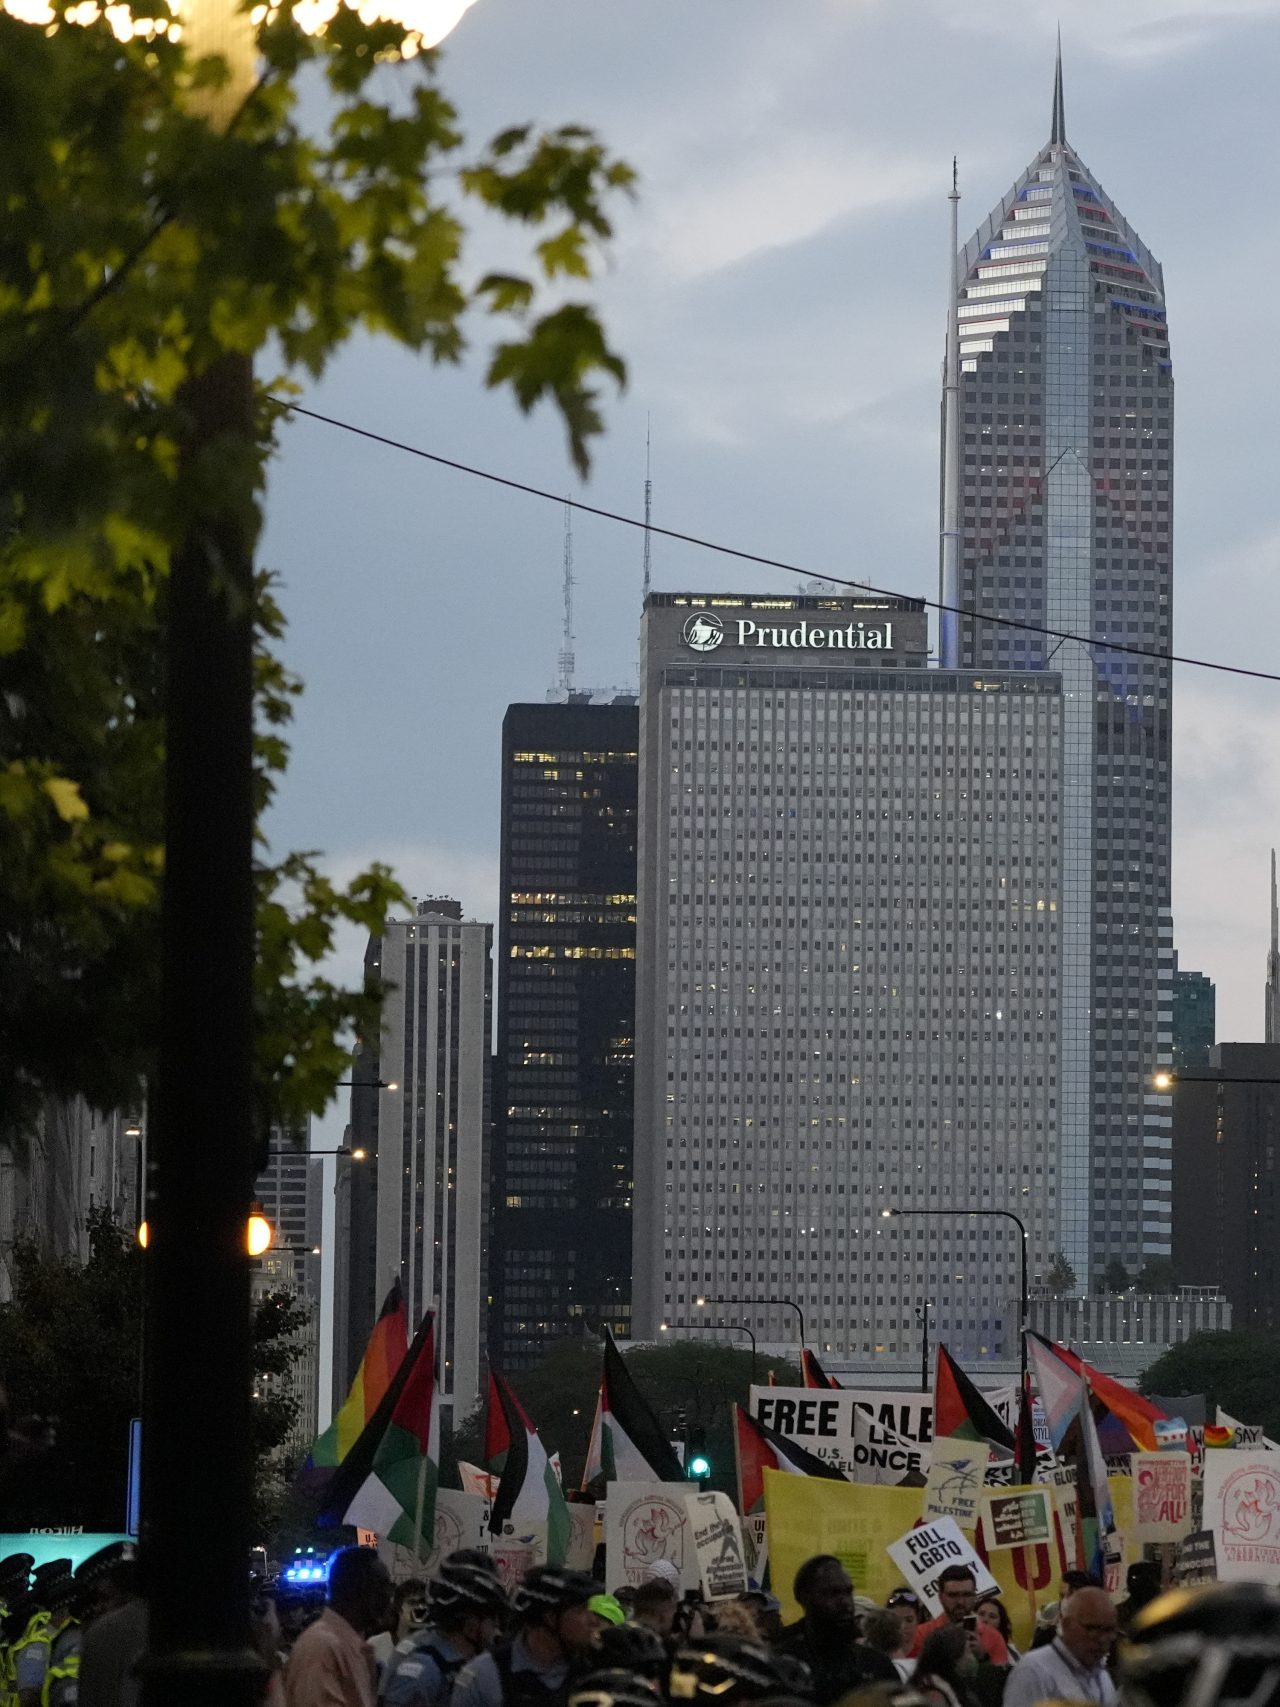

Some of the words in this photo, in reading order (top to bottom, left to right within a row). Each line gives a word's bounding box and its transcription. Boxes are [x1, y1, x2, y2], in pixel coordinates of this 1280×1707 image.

[736, 619, 894, 650] Prudential
[758, 1398, 840, 1438] FREE
[1234, 1427, 1260, 1444] SAY
[1158, 1500, 1187, 1525] ALL!
[905, 1527, 946, 1556] FULL
[910, 1540, 963, 1575] LGBTQ
